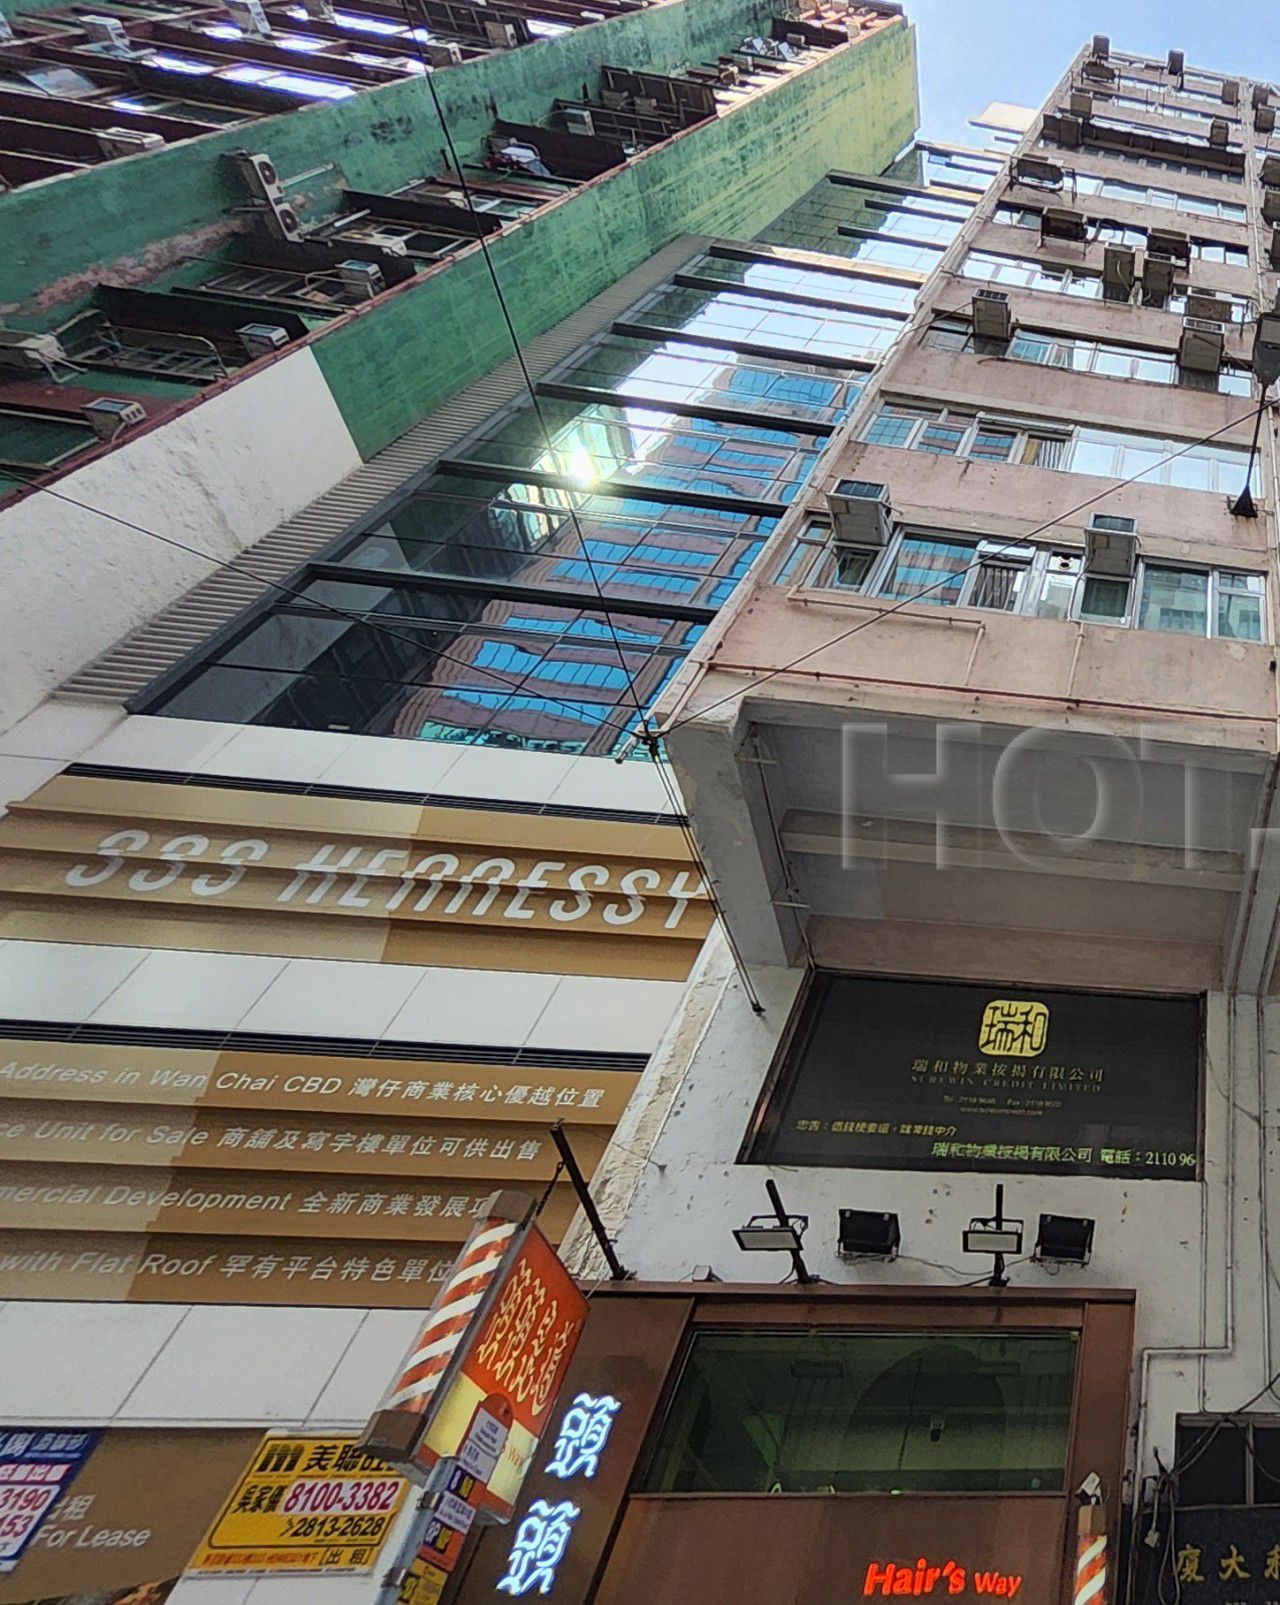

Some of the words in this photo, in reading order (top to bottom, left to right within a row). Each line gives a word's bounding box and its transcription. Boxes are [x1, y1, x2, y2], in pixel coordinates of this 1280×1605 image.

[980, 1003, 1048, 1053] 瑞和
[0, 1061, 108, 1084] Address
[115, 1066, 140, 1084] in
[149, 1069, 208, 1089] Wan
[216, 1072, 279, 1092] Chai
[284, 1076, 342, 1095] CBD
[911, 1059, 1104, 1082] 瑞和物業按揭有限公司
[347, 1078, 607, 1109] 灣仔商業核心優越位置
[34, 1120, 97, 1142] Unit
[100, 1123, 140, 1144] for
[146, 1125, 209, 1146] Sale
[216, 1127, 543, 1161] 商舖及寫字樓單位可供出售
[104, 1186, 292, 1213] Development
[0, 1251, 61, 1272] with
[70, 1251, 133, 1274] Flat
[139, 1254, 217, 1276] Roof
[283, 1480, 399, 1514] 8100-3382
[29, 1524, 77, 1548] For
[75, 1525, 151, 1548] Lease
[290, 1516, 386, 1538] 2813-2628
[863, 1557, 967, 1596] Hair's
[974, 1571, 1023, 1598] Way
